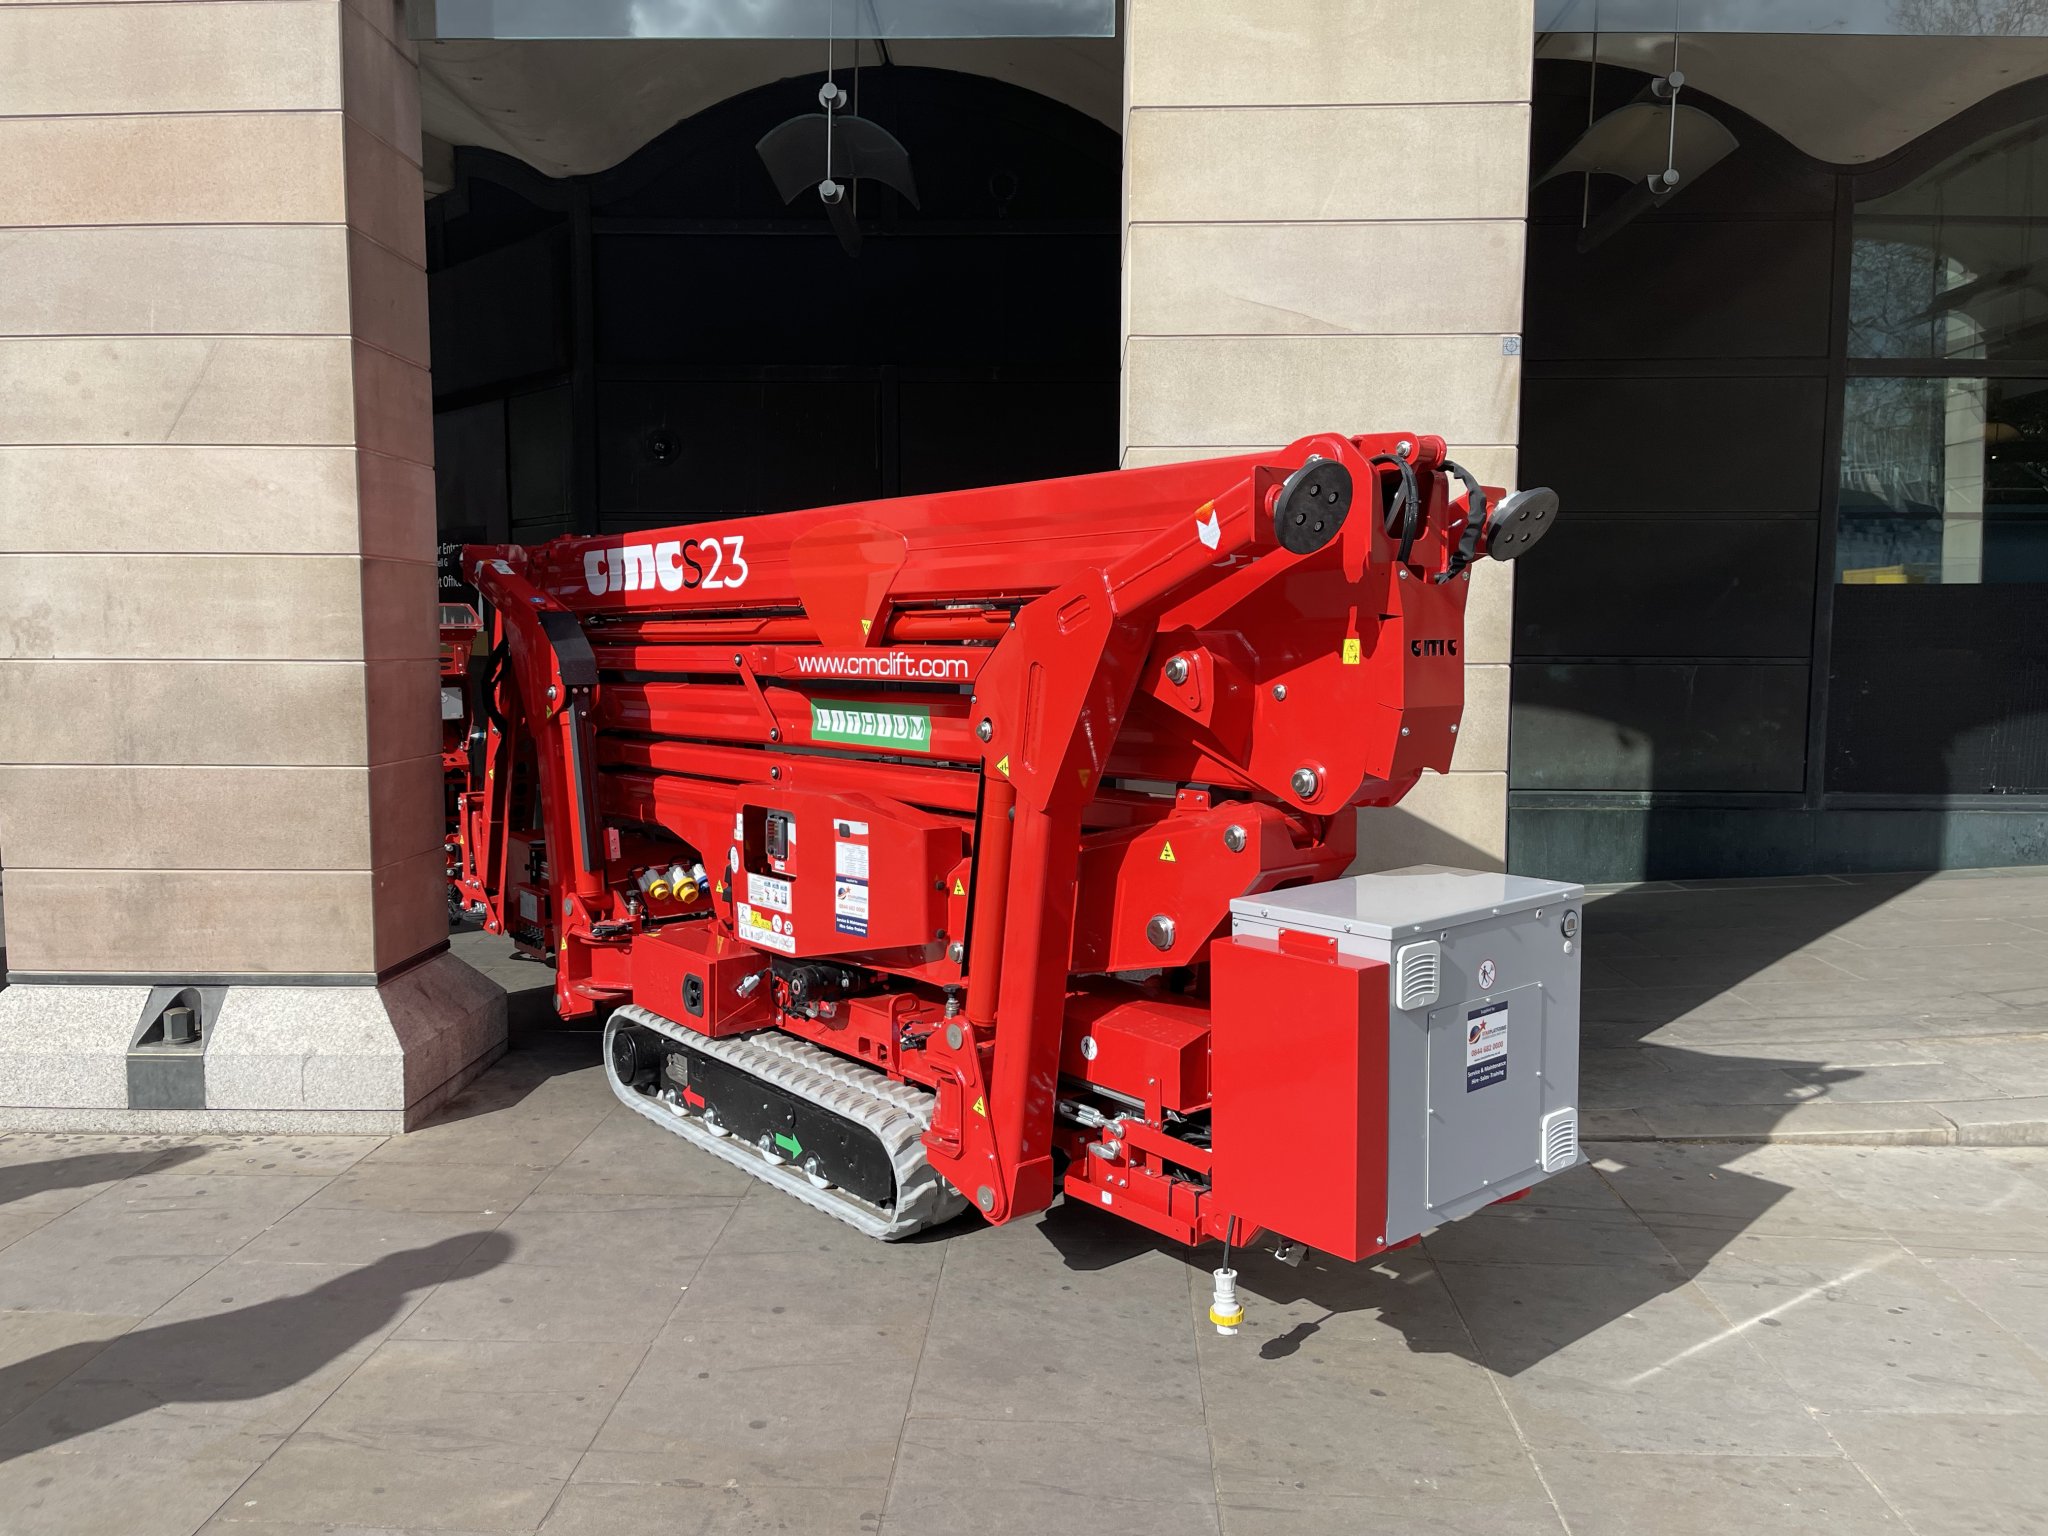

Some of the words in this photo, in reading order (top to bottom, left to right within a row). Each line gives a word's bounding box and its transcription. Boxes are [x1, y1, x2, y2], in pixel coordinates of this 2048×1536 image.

[797, 651, 968, 678] www.cmclift.com
[817, 708, 925, 741] LITHIUM
[1467, 1069, 1480, 1078] Service
[1484, 1060, 1507, 1072] Maintenance
